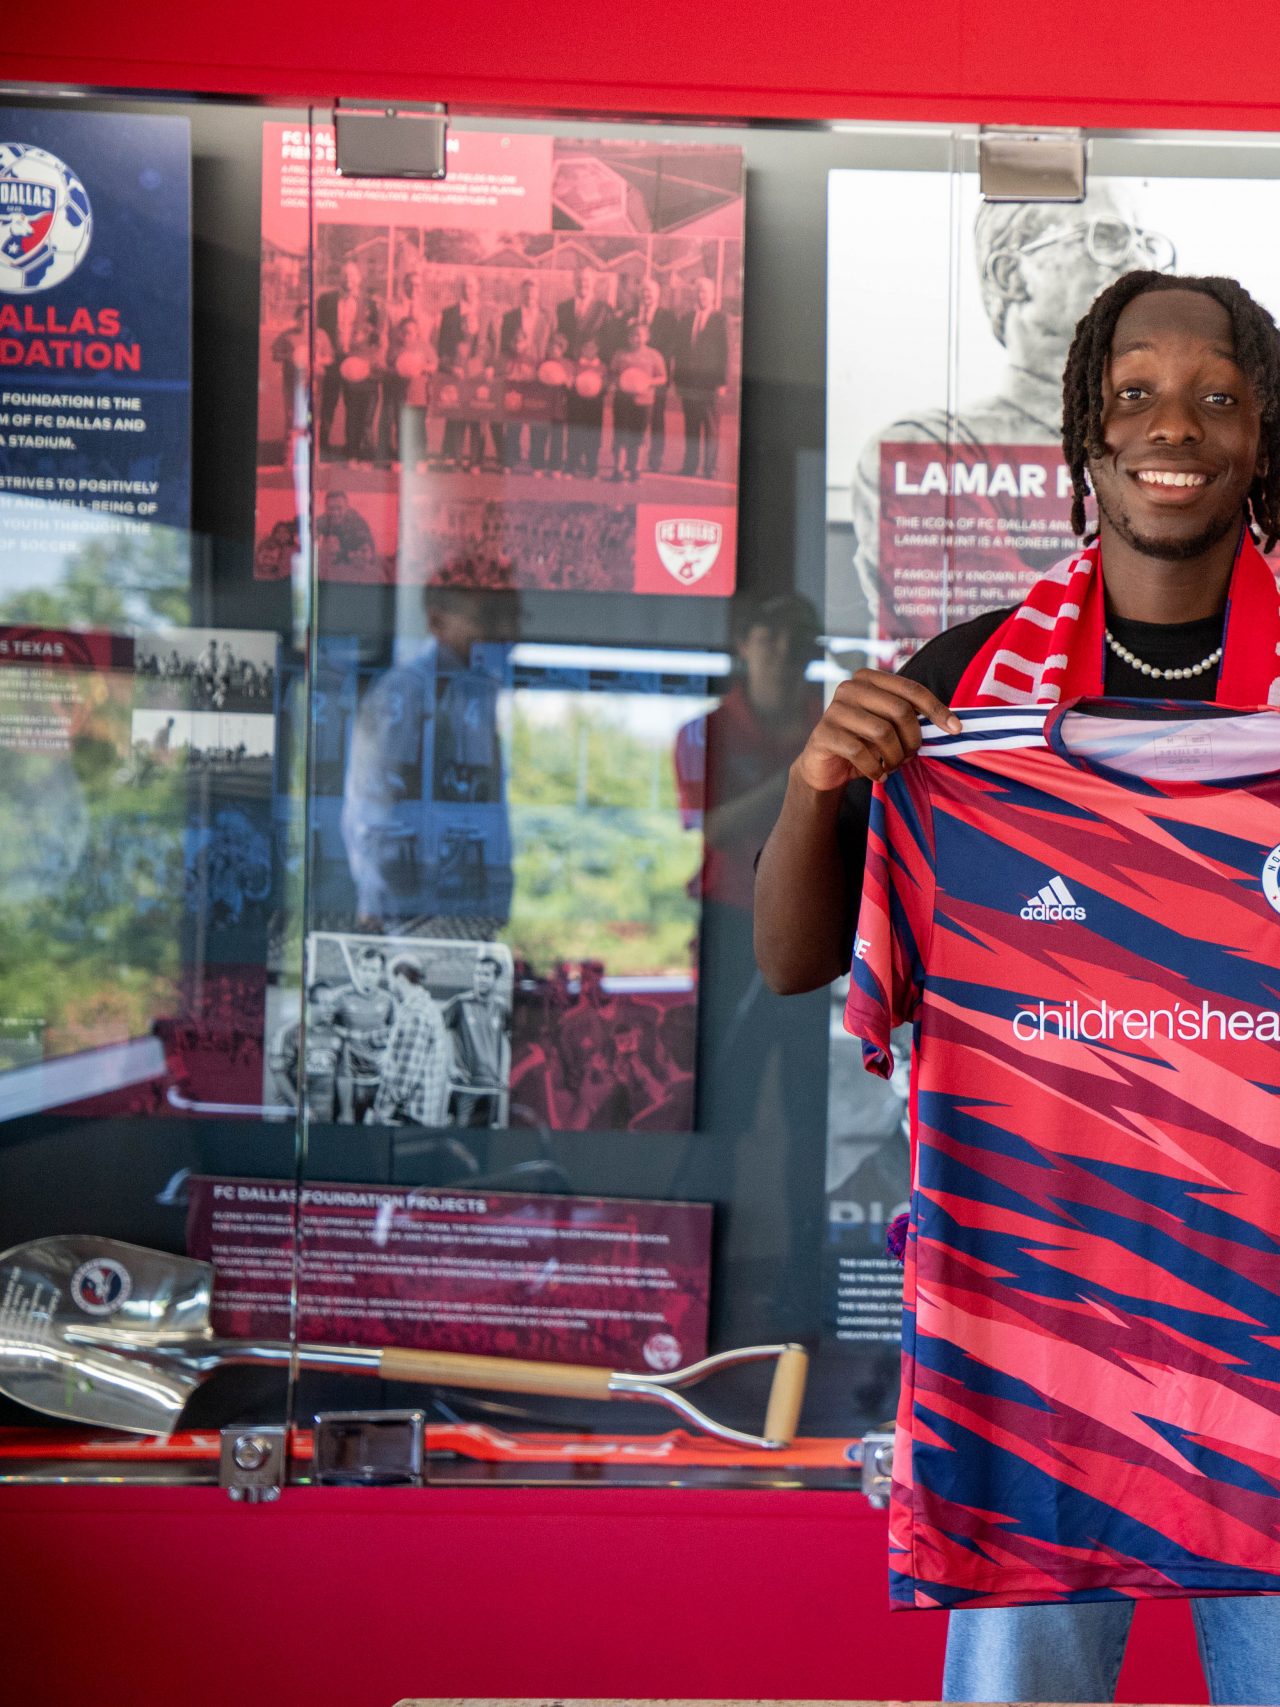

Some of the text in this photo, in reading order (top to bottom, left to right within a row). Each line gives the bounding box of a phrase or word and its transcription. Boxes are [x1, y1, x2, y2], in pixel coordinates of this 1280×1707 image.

[0, 183, 51, 209] DALLAS
[2, 392, 142, 411] FOUNDATION IS THE
[12, 414, 32, 427] OF
[34, 415, 53, 428] FC
[56, 416, 111, 430] DALLAS
[113, 418, 147, 432] AND
[8, 435, 77, 449] STADIUM.
[57, 478, 77, 491] TO
[79, 479, 159, 494] POSITIVELY
[895, 461, 1047, 497] LAMAR
[137, 501, 158, 515] OF
[895, 517, 920, 528] THE
[957, 519, 974, 530] OF
[977, 519, 993, 531] FC
[996, 519, 1046, 532] DALLAS
[895, 536, 938, 548] LAMAR
[978, 538, 989, 548] IS
[992, 538, 1002, 548] A
[1004, 537, 1059, 550] PIONEER
[966, 571, 1017, 584] KNOWN
[954, 587, 978, 600] THE
[13, 641, 64, 657] TEXAS
[1020, 904, 1087, 921] adidas
[213, 1185, 487, 1213] FC DALLAS FOUNDATION PROJECTS
